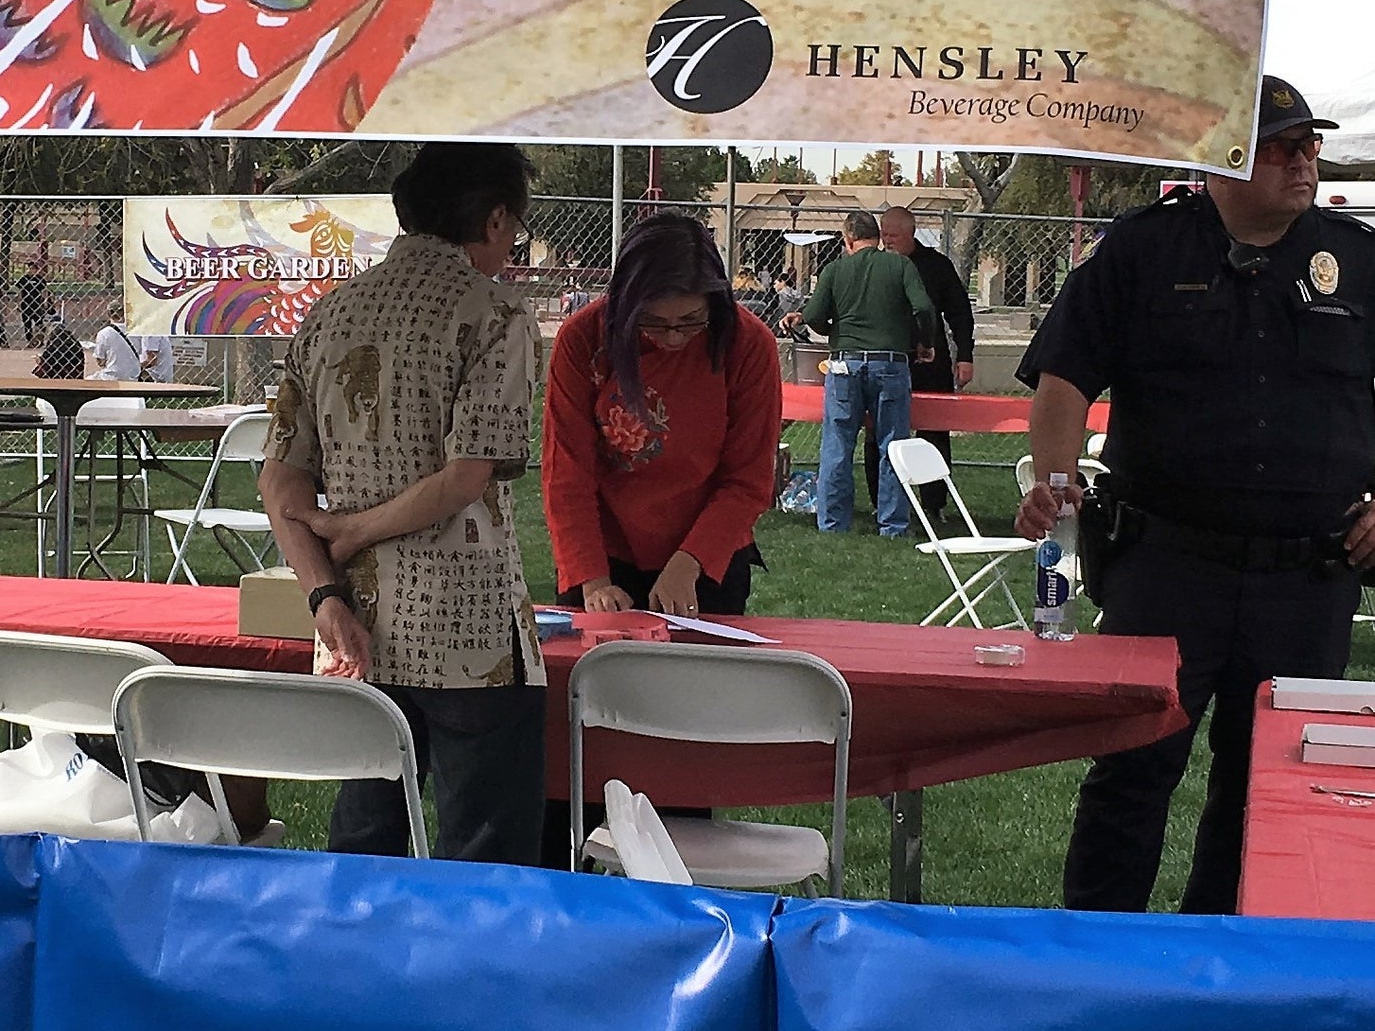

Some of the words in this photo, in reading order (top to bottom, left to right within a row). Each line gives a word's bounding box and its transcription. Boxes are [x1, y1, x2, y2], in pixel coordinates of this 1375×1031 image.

[806, 44, 1089, 84] HENSLEY
[908, 90, 1021, 124] Beverage
[1026, 92, 1145, 132] Company
[165, 257, 242, 280] BEER
[247, 257, 372, 280] GARDEN
